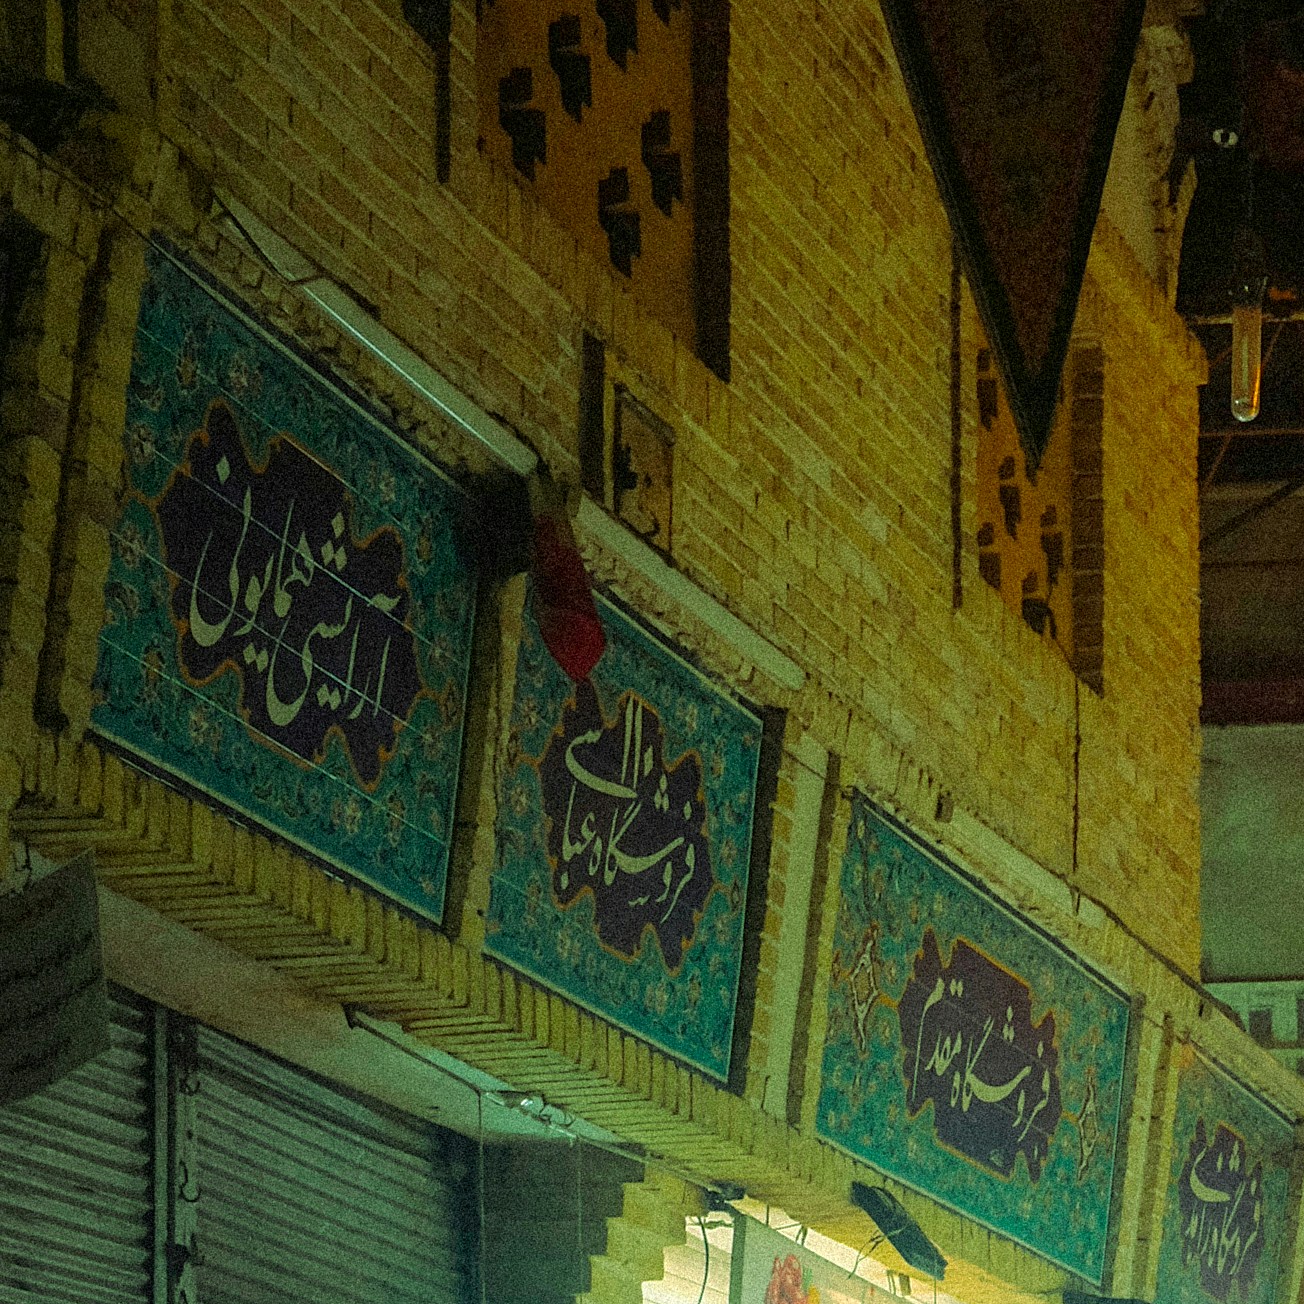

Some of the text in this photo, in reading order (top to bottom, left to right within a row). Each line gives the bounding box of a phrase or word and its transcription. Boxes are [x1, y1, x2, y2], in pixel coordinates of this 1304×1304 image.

[265, 511, 401, 727] آرایشی
[588, 773, 696, 924] فروشگاه
[949, 1004, 1050, 1143] فروشگاه
